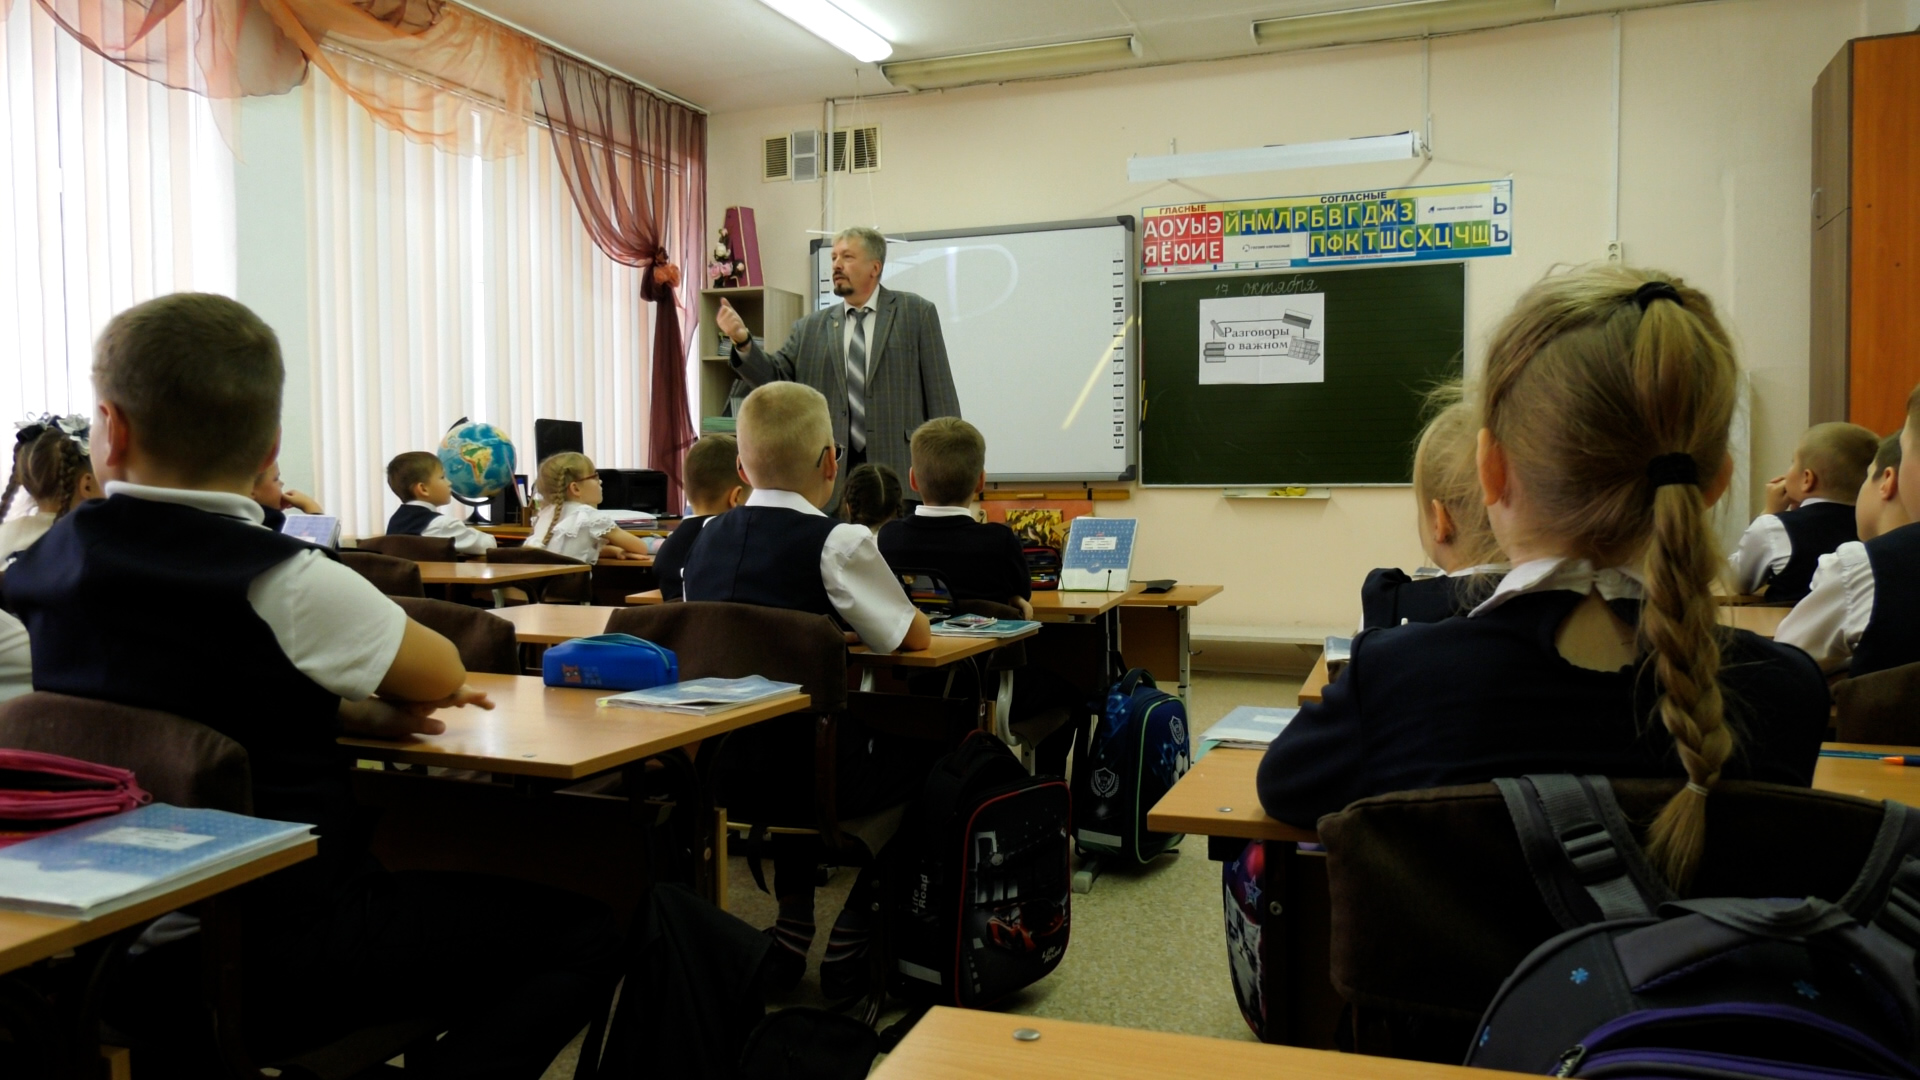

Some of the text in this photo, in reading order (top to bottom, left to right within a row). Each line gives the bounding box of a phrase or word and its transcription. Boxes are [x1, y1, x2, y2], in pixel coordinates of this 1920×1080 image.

[1320, 191, 1387, 204] СОГЛАСНЫЕ
[1159, 204, 1207, 215] ГЛАСНЫЕ
[1215, 274, 1317, 297] 17 октября
[1224, 326, 1289, 339] Разговоры
[1239, 341, 1288, 350] важном
